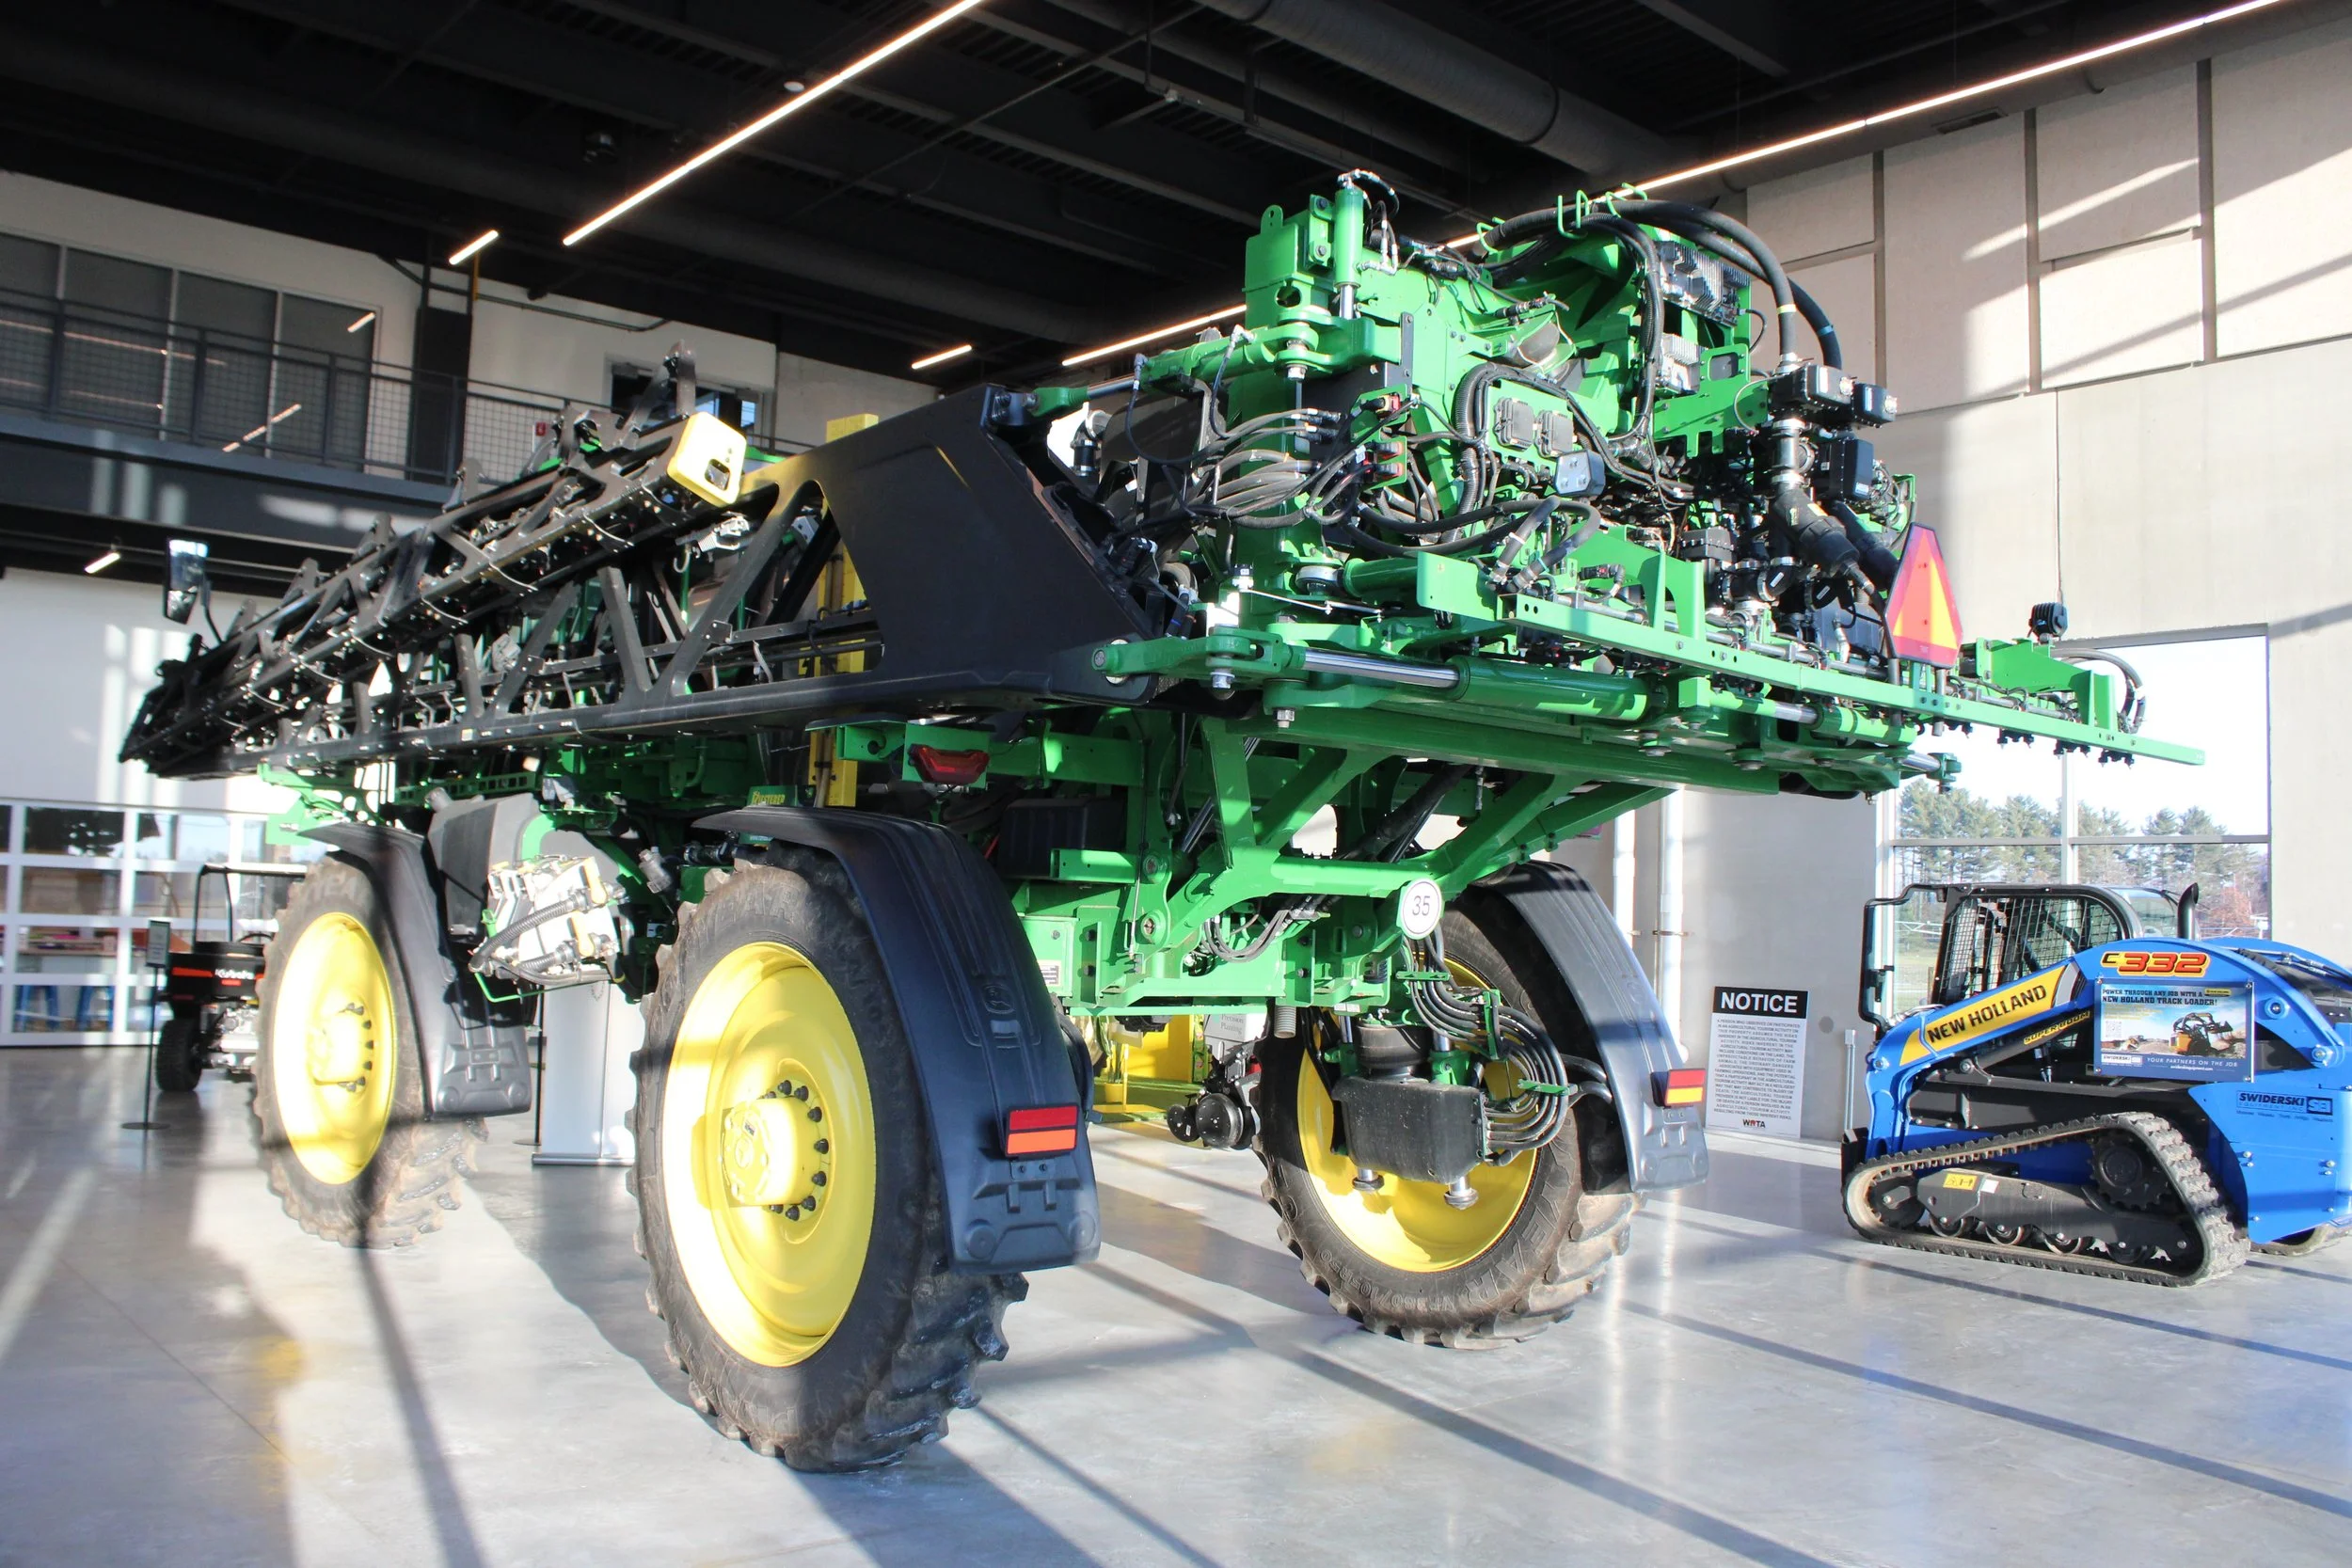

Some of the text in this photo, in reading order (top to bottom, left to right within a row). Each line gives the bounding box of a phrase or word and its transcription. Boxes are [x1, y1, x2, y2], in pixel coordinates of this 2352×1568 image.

[1412, 895, 1430, 916] 35
[215, 968, 255, 980] Kubota
[1721, 992, 1798, 1014] NOTICE
[1927, 985, 2047, 1043] NEW HOLLAND
[2239, 1093, 2304, 1106] SWIDERSKI
